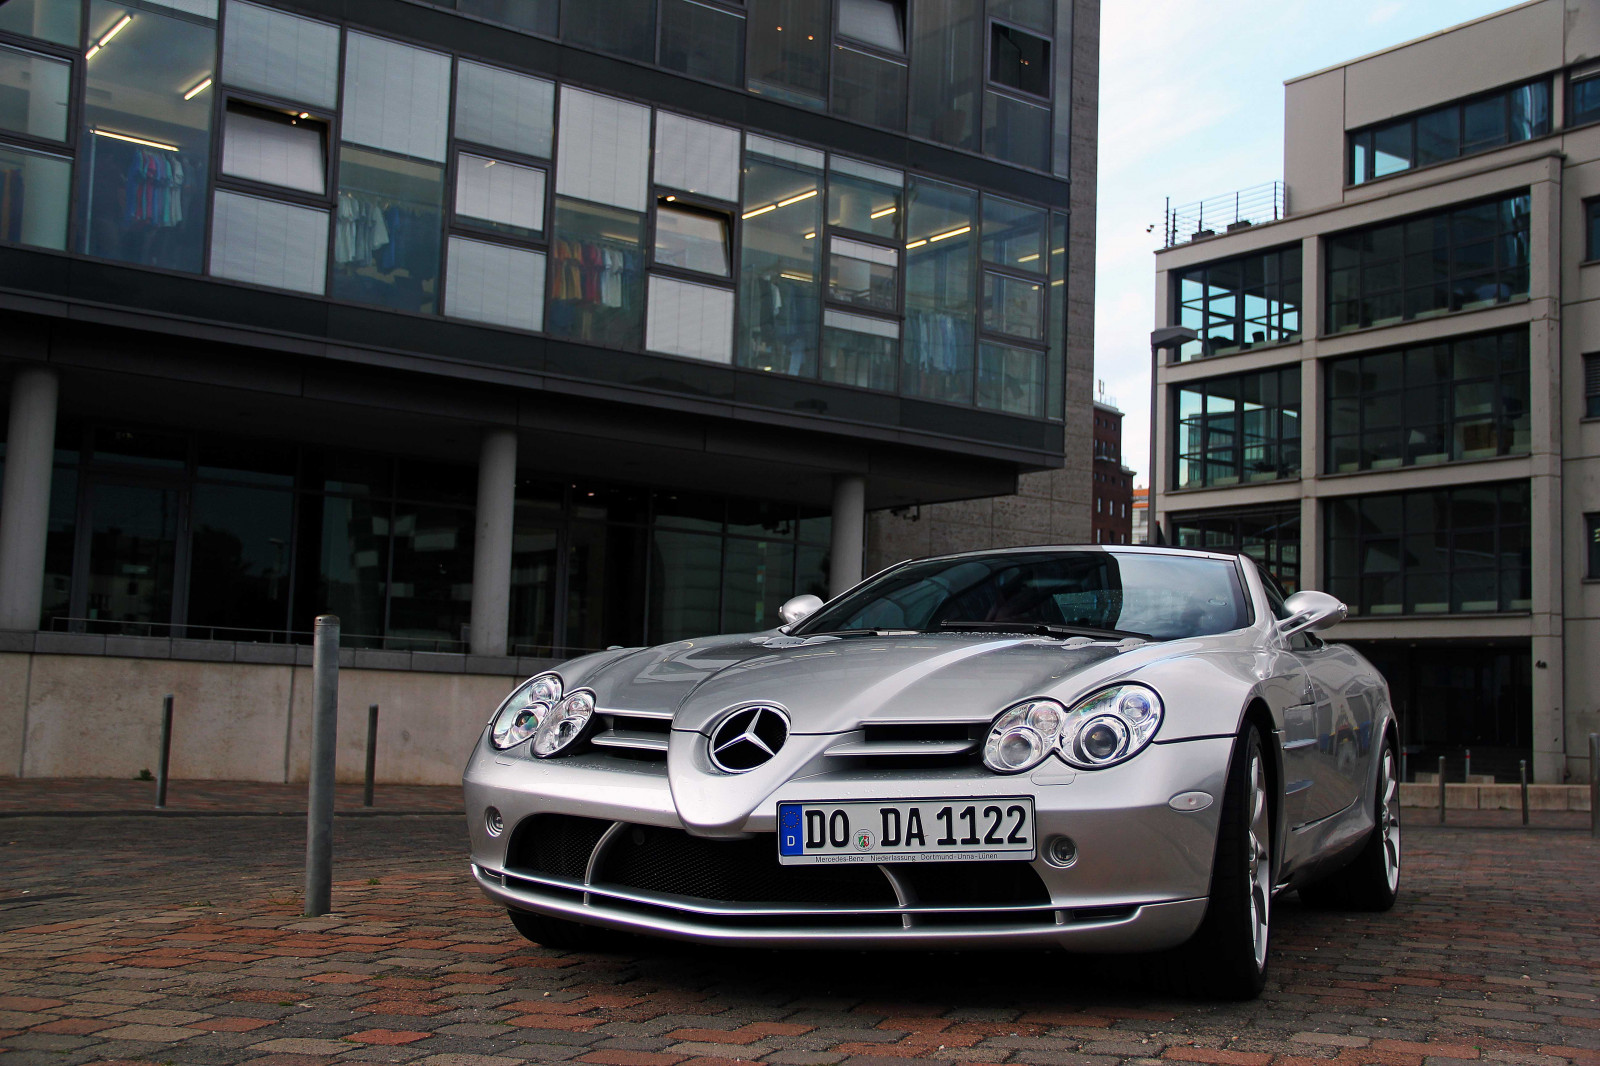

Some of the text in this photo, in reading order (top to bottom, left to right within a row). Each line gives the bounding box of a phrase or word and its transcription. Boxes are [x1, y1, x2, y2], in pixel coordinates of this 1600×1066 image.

[805, 805, 1027, 849] DO DA 1122
[787, 835, 795, 846] D
[815, 855, 864, 863] Mercedes-Benz
[870, 854, 916, 862] Niederlassung
